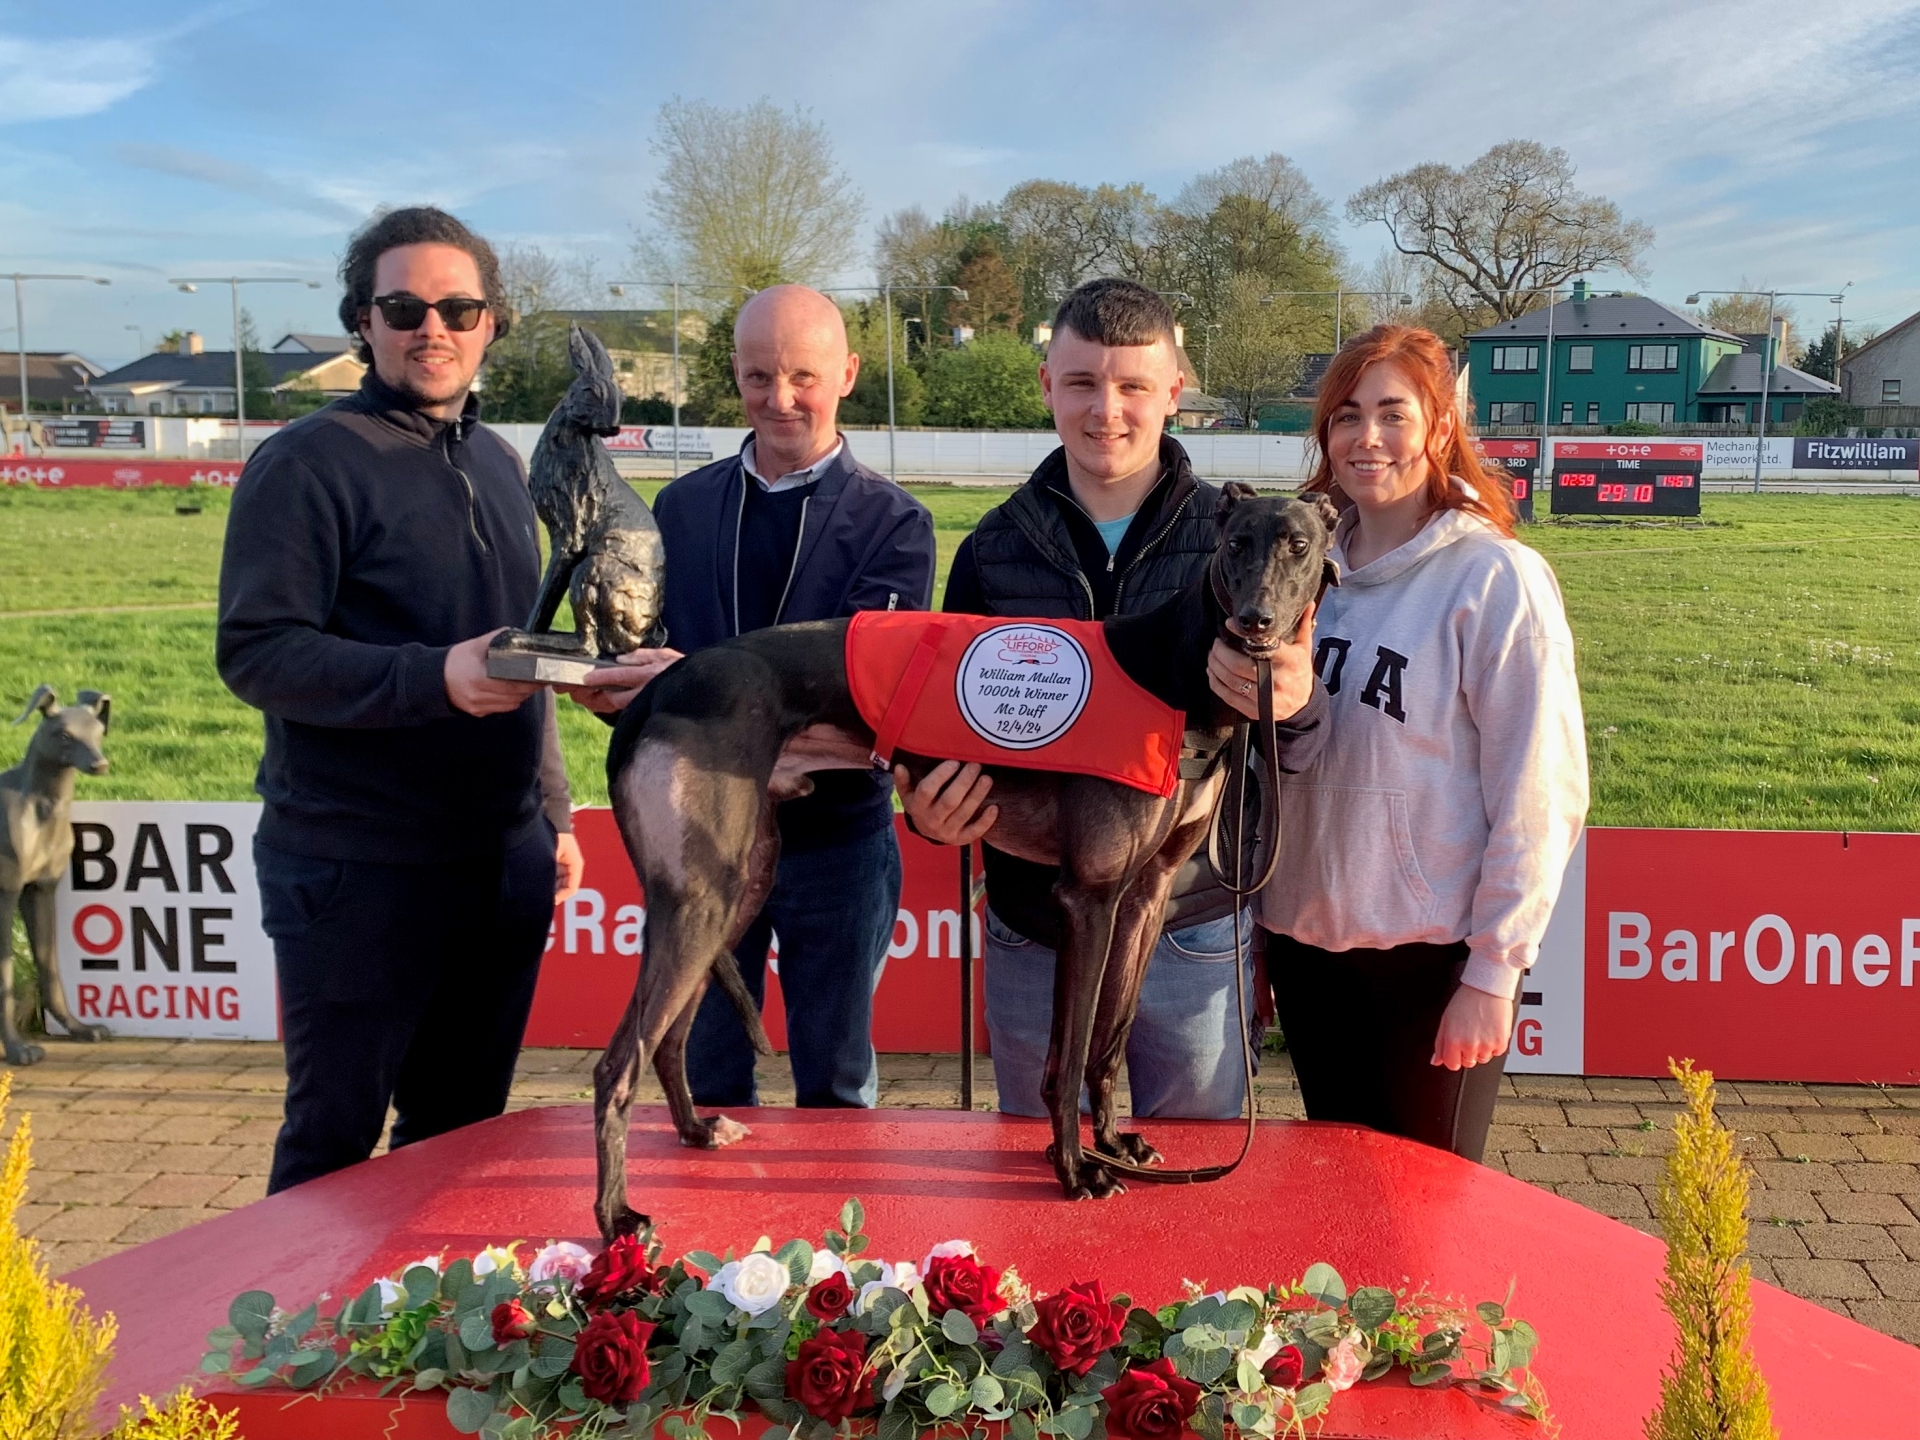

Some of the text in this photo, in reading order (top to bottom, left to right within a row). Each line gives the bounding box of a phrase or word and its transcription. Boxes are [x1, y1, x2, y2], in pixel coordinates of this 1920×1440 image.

[1807, 442, 1906, 460] Fitzwilliam
[1507, 458, 1527, 467] 3RD
[1616, 460, 1640, 469] TIME
[1706, 454, 1782, 466] Pipework Ltd.
[1513, 479, 1527, 499] 0
[1007, 641, 1053, 652] LIFFORD
[979, 668, 1071, 685] William Mullan
[978, 684, 1069, 701] 1000th Winner
[994, 703, 1047, 718] Mc Duff
[996, 720, 1041, 735] 12/4/24
[71, 822, 237, 894] BAR
[72, 903, 238, 974] ONE
[77, 983, 240, 1021] RACING
